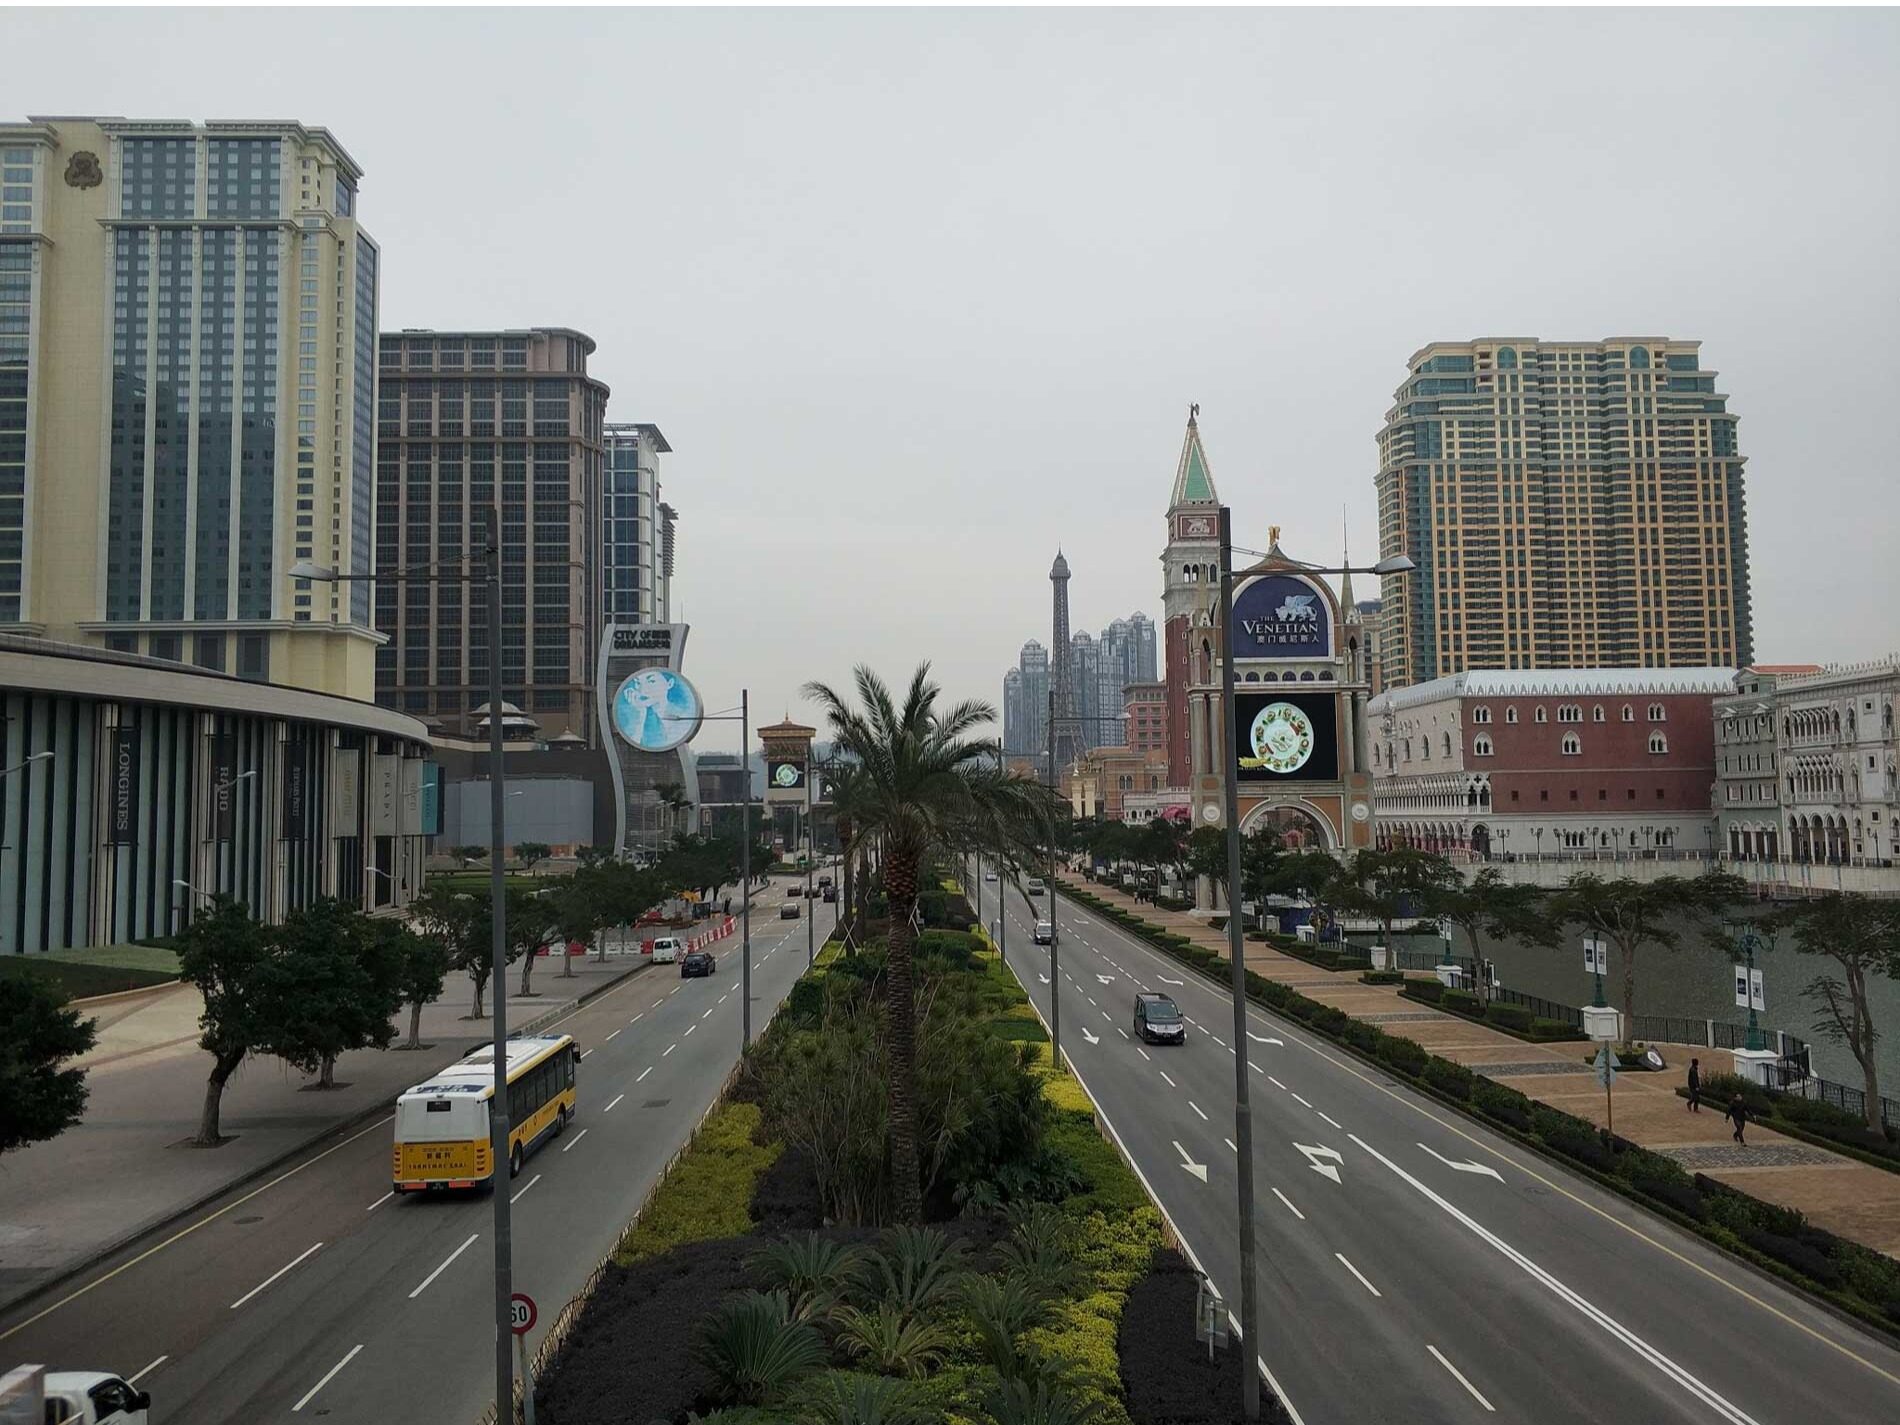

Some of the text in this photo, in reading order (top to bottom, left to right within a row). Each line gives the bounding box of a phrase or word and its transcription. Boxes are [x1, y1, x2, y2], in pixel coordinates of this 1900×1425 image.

[614, 630, 637, 640] CITY
[1242, 620, 1318, 634] VENETIAN
[117, 742, 131, 831] LONGINES
[219, 766, 229, 811] RADO
